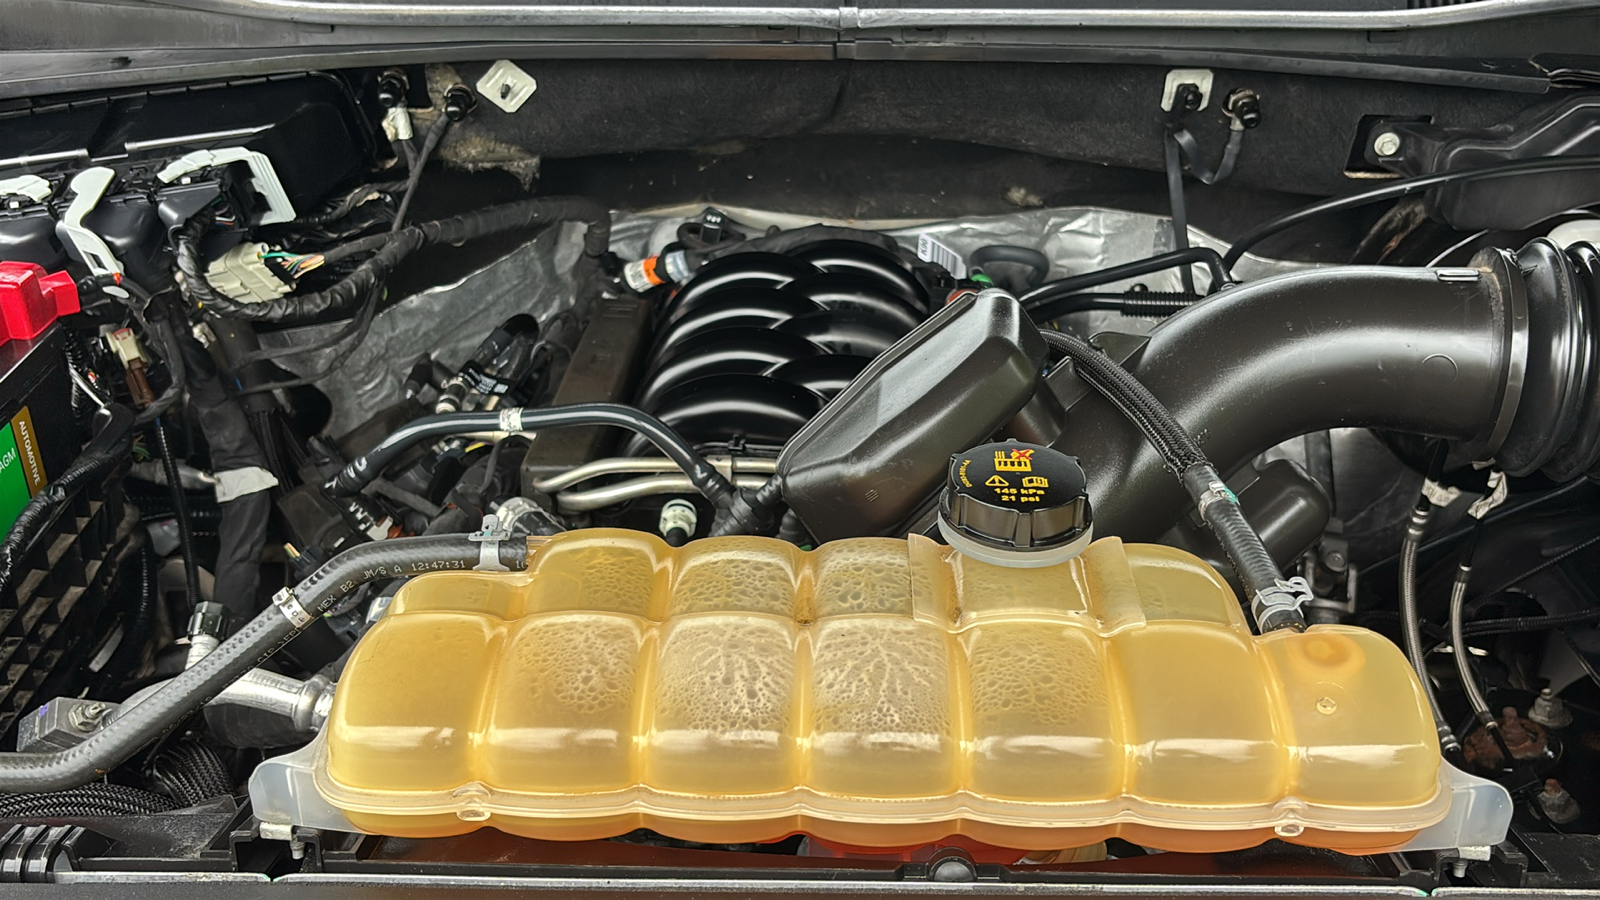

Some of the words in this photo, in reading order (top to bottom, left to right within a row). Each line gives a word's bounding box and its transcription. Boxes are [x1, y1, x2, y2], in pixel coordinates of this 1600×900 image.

[0, 447, 17, 474] AGM
[18, 420, 42, 486] AUTOMOTIVE
[317, 594, 337, 612] MEX
[340, 580, 355, 593] B2
[411, 560, 466, 571] 12:47:31
